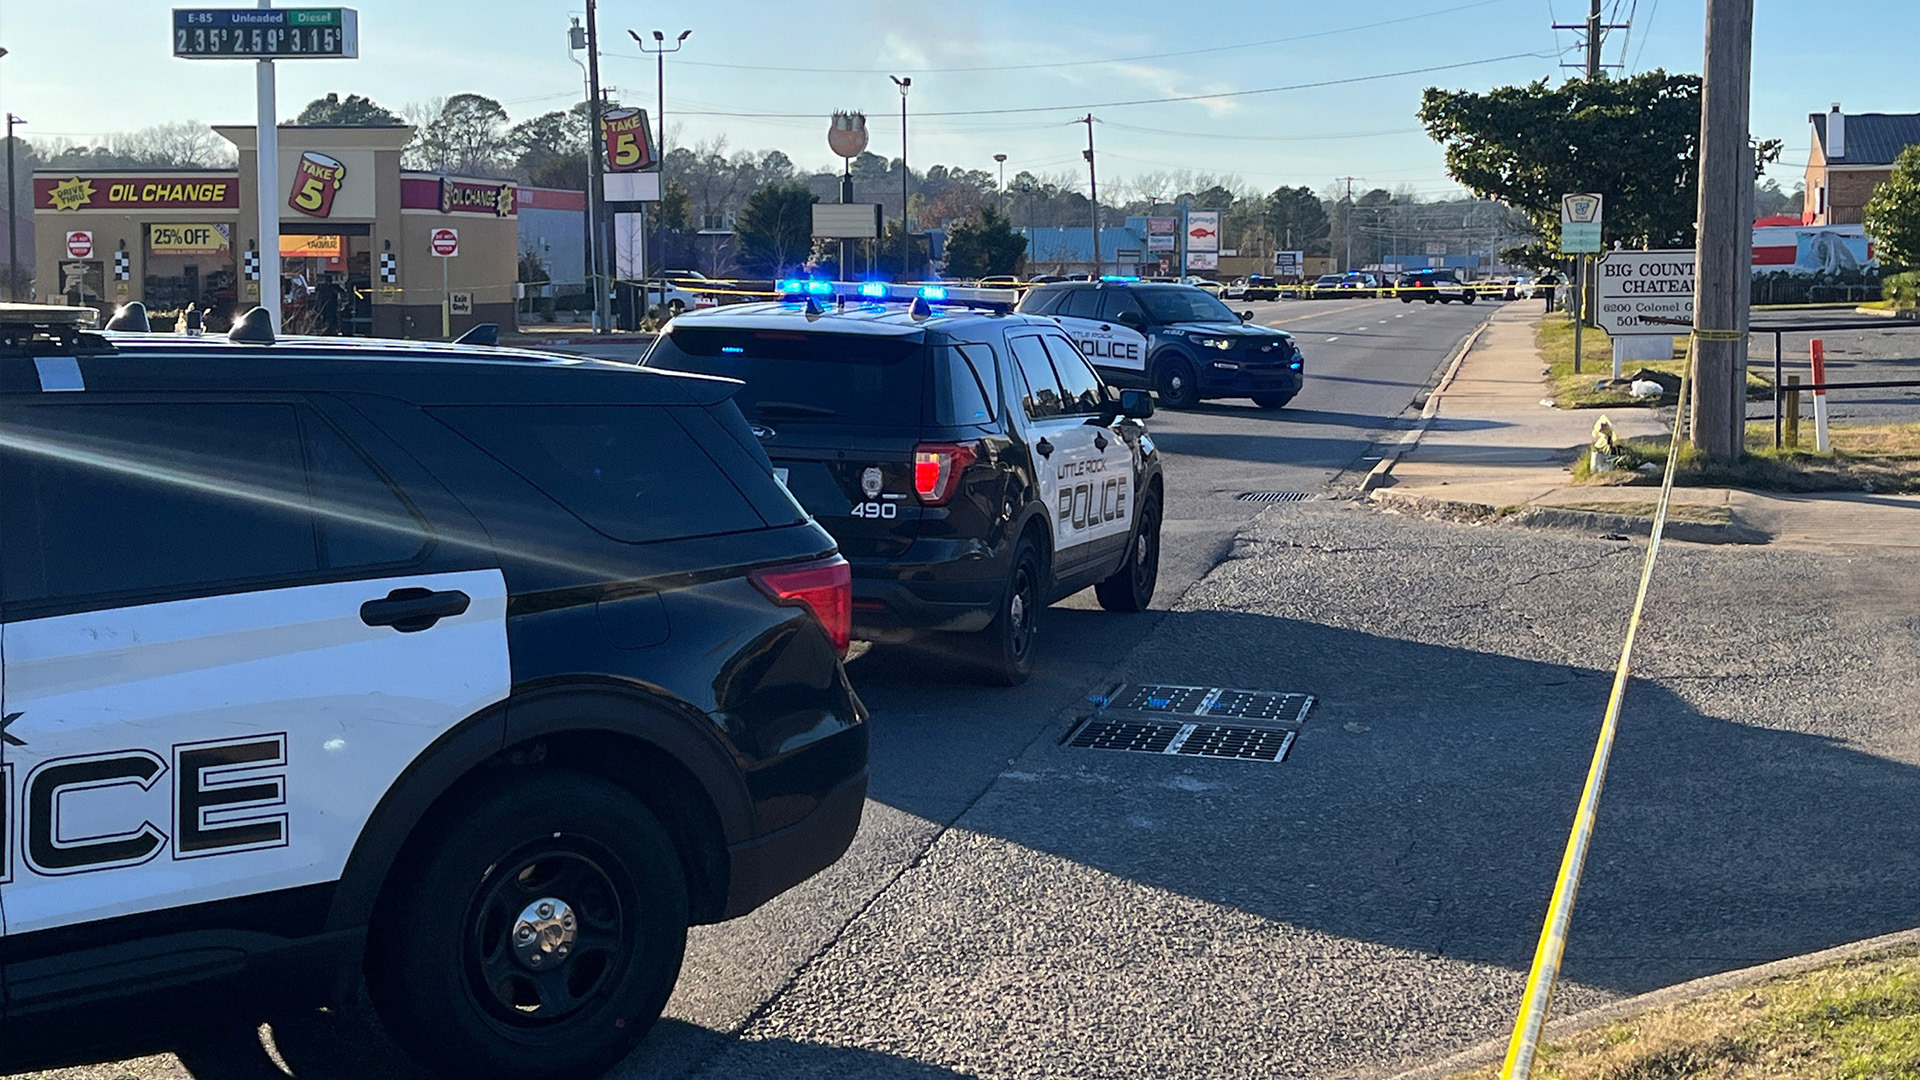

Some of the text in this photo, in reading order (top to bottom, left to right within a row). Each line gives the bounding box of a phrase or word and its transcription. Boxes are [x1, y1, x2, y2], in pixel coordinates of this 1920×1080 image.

[188, 13, 213, 23] E-85
[231, 12, 283, 23] Unleaded
[298, 12, 331, 22] Diesel
[608, 116, 640, 132] TAKE
[616, 133, 640, 165] 5
[302, 160, 333, 181] TAKE
[57, 185, 84, 198] DRIVE
[61, 192, 85, 204] THRU
[109, 184, 227, 201] OIL CHANGE
[295, 178, 324, 210] 5
[465, 189, 497, 207] CHANGE
[154, 229, 183, 245] 25%
[184, 229, 210, 245] OFF
[1604, 262, 1695, 277] BIG COUNT
[454, 295, 467, 303] Exit
[1603, 304, 1631, 312] 6200
[1636, 302, 1680, 312] Colonel
[452, 303, 469, 312] Only
[1057, 457, 1107, 480] LITTLE ROCK
[851, 502, 897, 519] 490
[1057, 476, 1127, 534] POLICE
